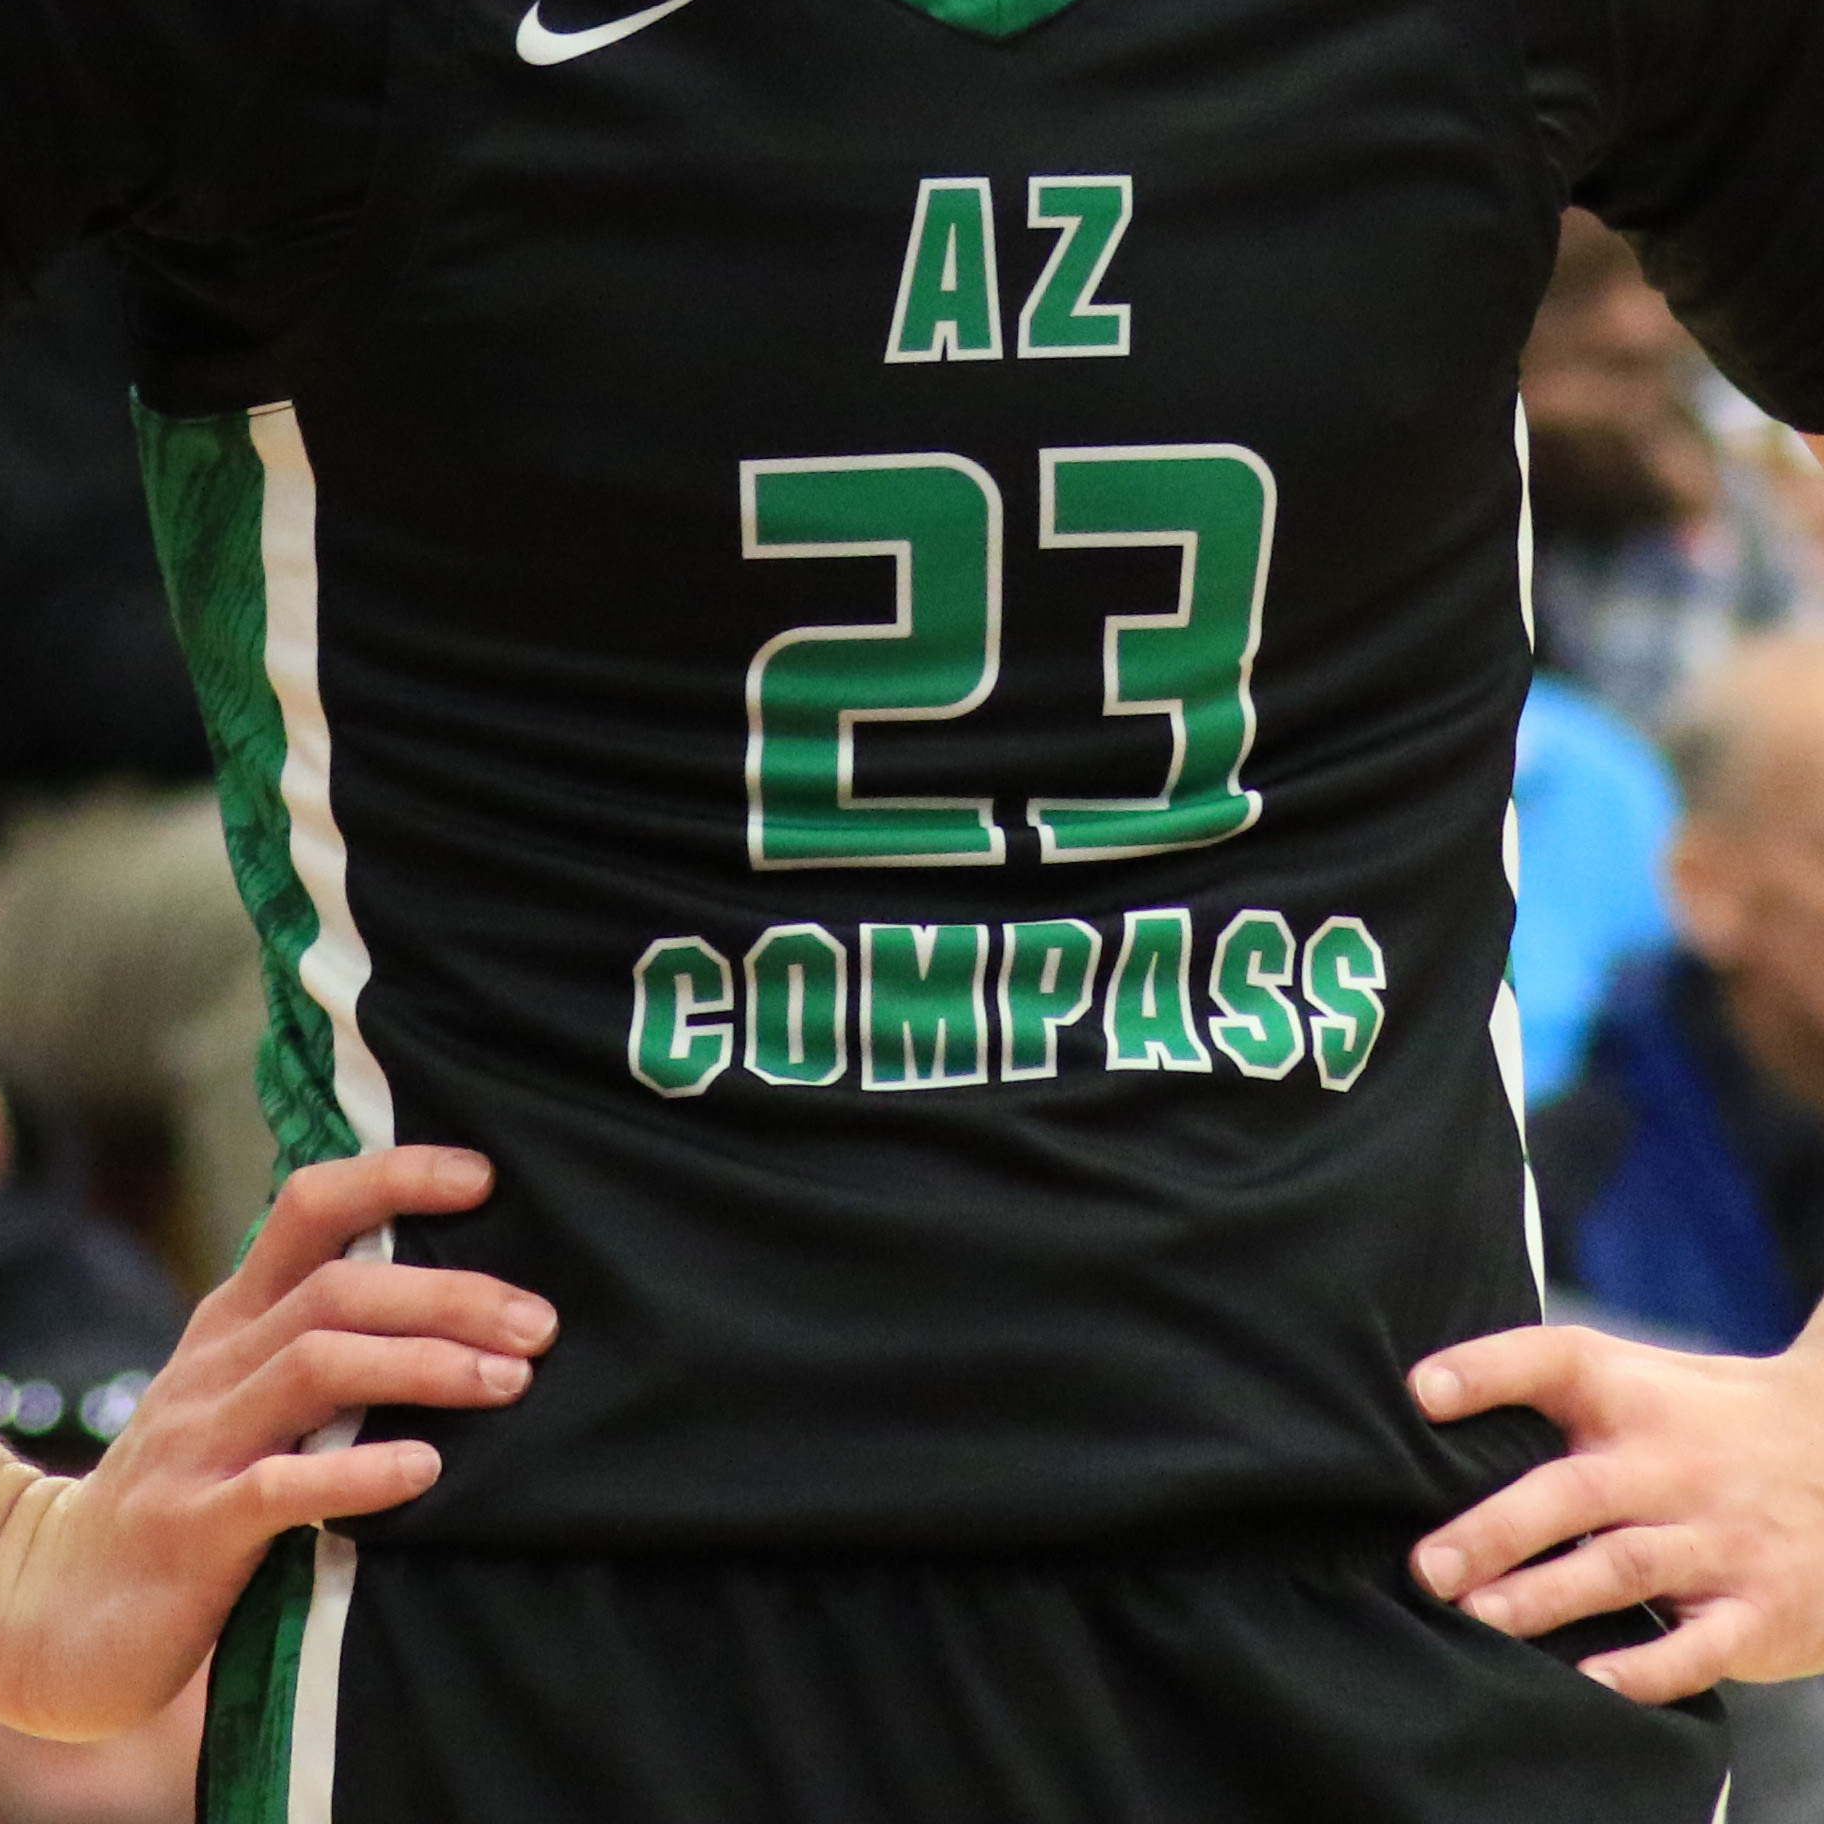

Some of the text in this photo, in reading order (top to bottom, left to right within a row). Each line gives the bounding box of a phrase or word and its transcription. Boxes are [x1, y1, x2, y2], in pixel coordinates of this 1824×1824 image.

[884, 175, 1132, 363] AZ
[739, 443, 1277, 871] 23
[628, 907, 1387, 1099] COMPASS
